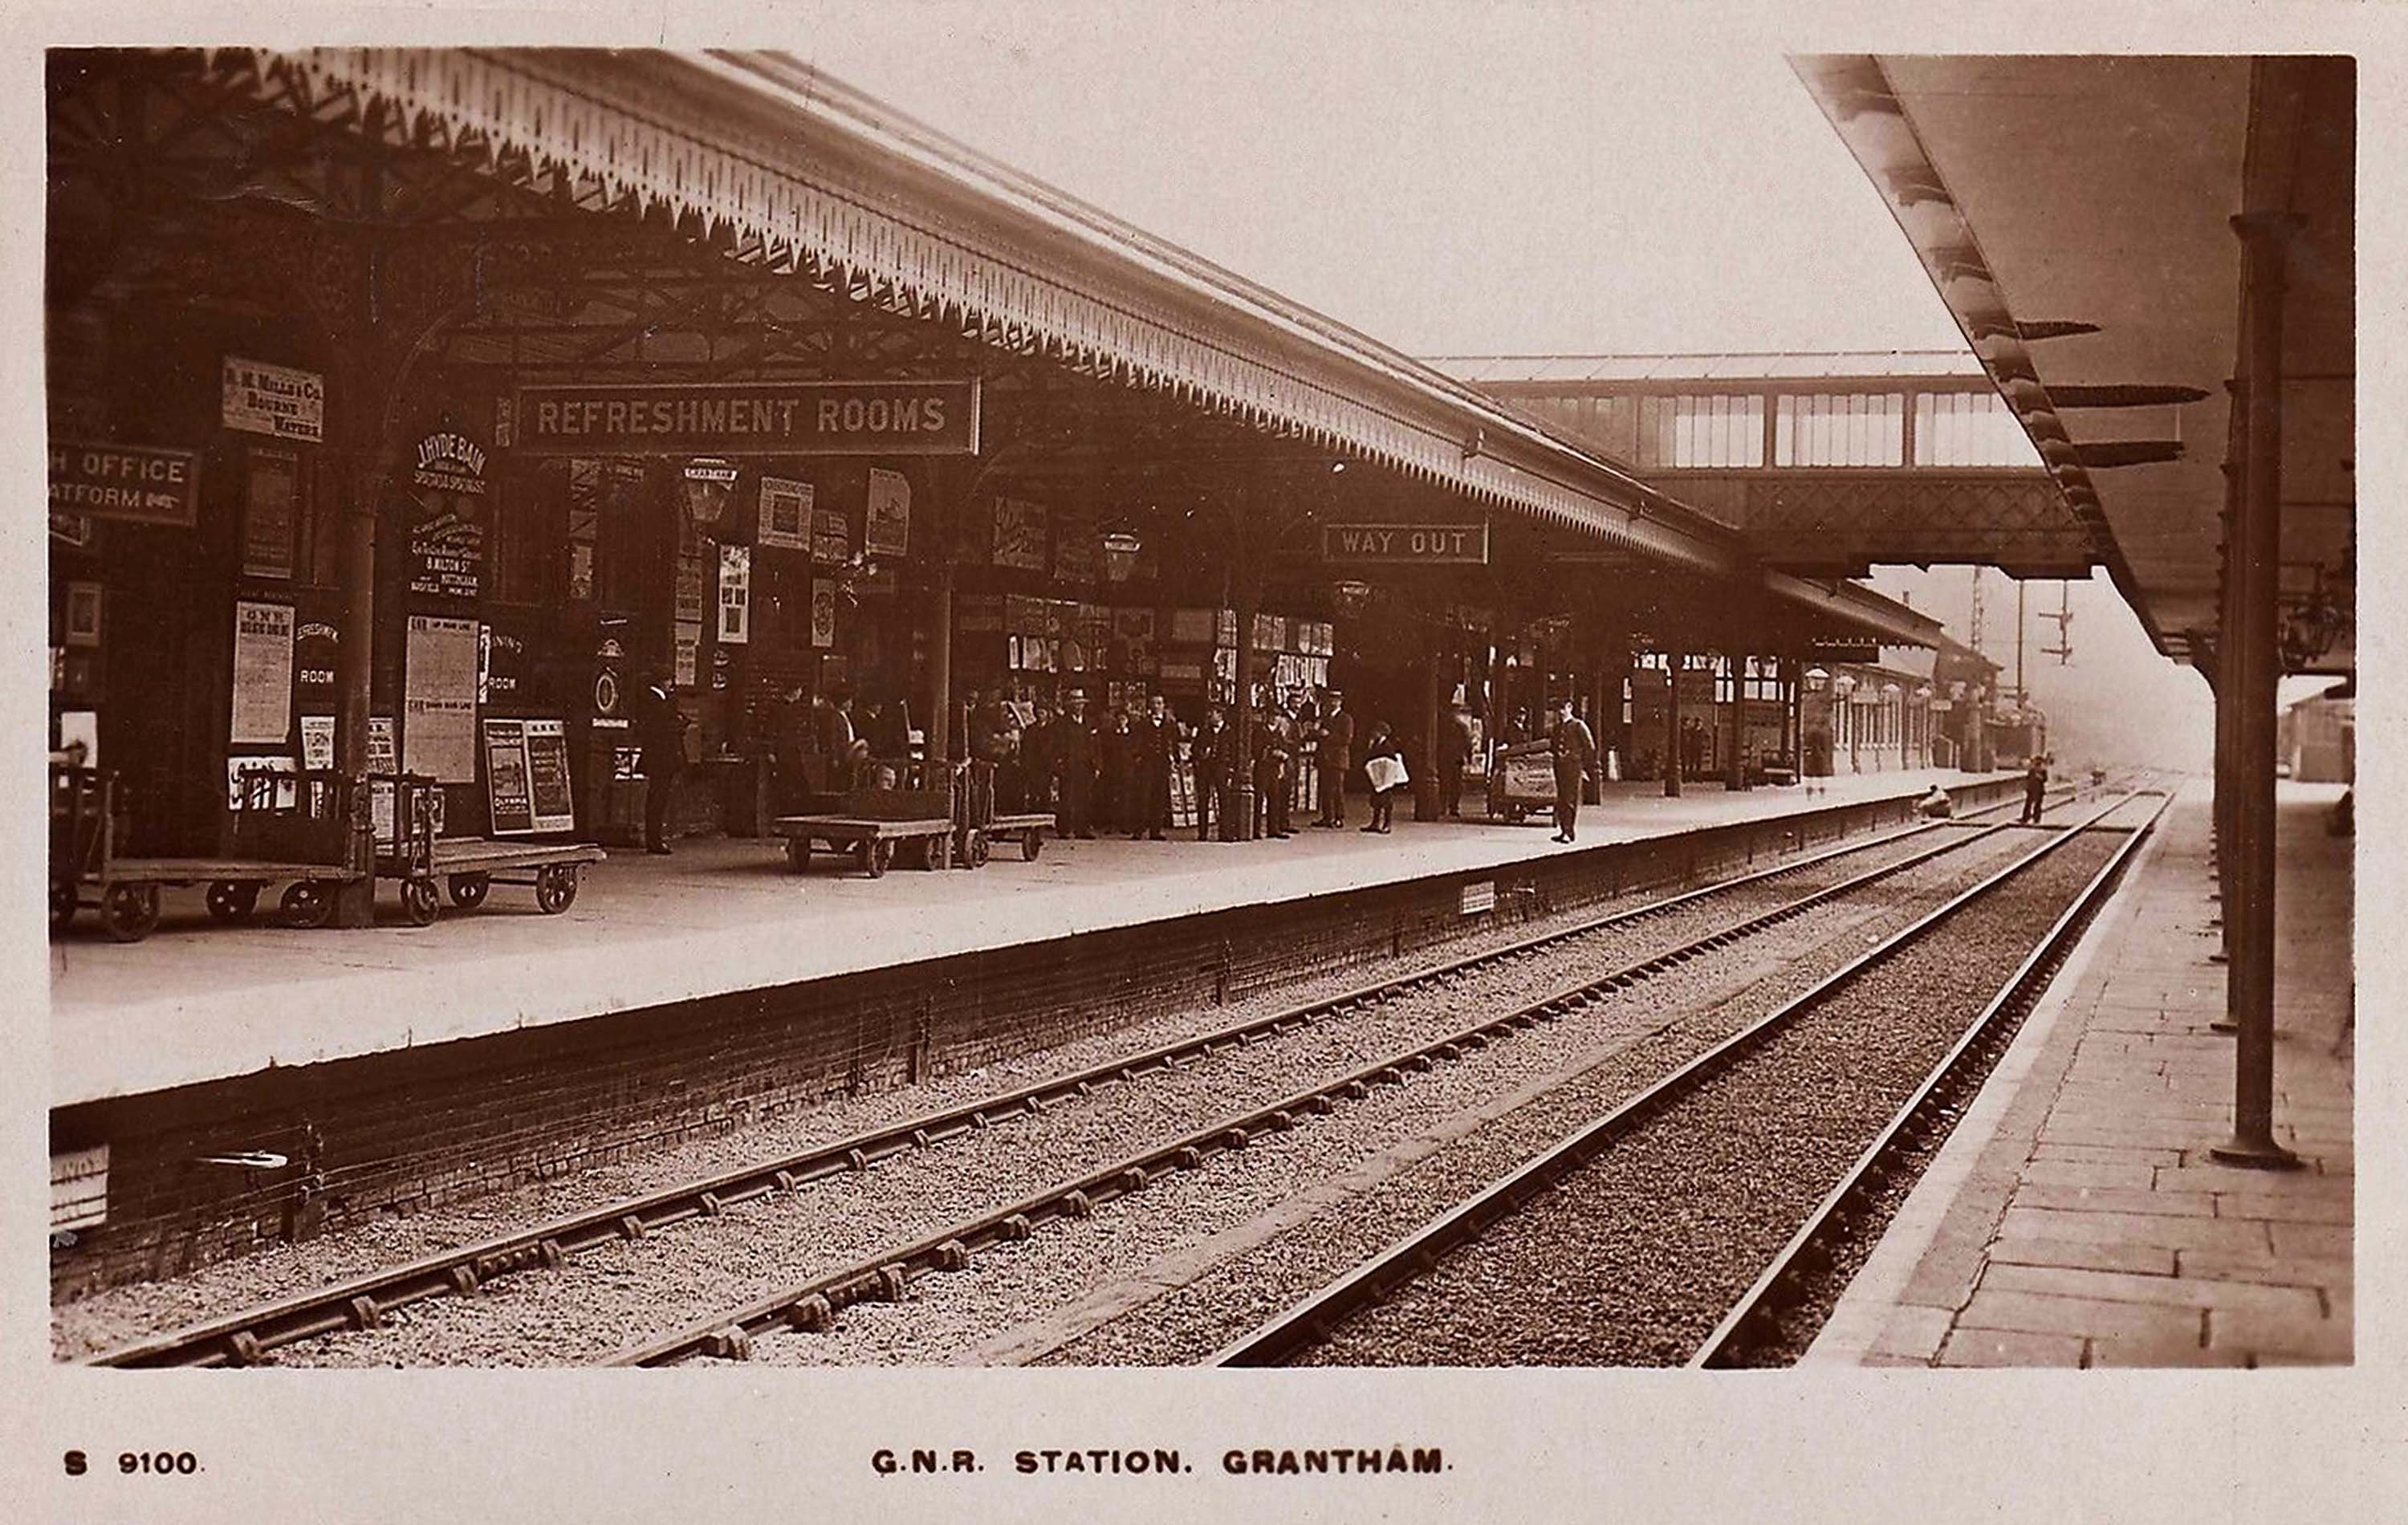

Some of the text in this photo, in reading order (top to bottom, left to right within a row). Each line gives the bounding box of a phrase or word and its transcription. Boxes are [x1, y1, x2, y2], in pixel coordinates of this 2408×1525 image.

[539, 400, 799, 434] REFRESHMENT
[817, 398, 946, 433] ROOMS
[83, 453, 185, 483] OFFICE
[49, 483, 140, 508] ATFORM
[1341, 531, 1466, 554] WAY OUT
[492, 635, 523, 654] INING
[299, 669, 335, 684] ROOM
[488, 677, 517, 690] ROOM
